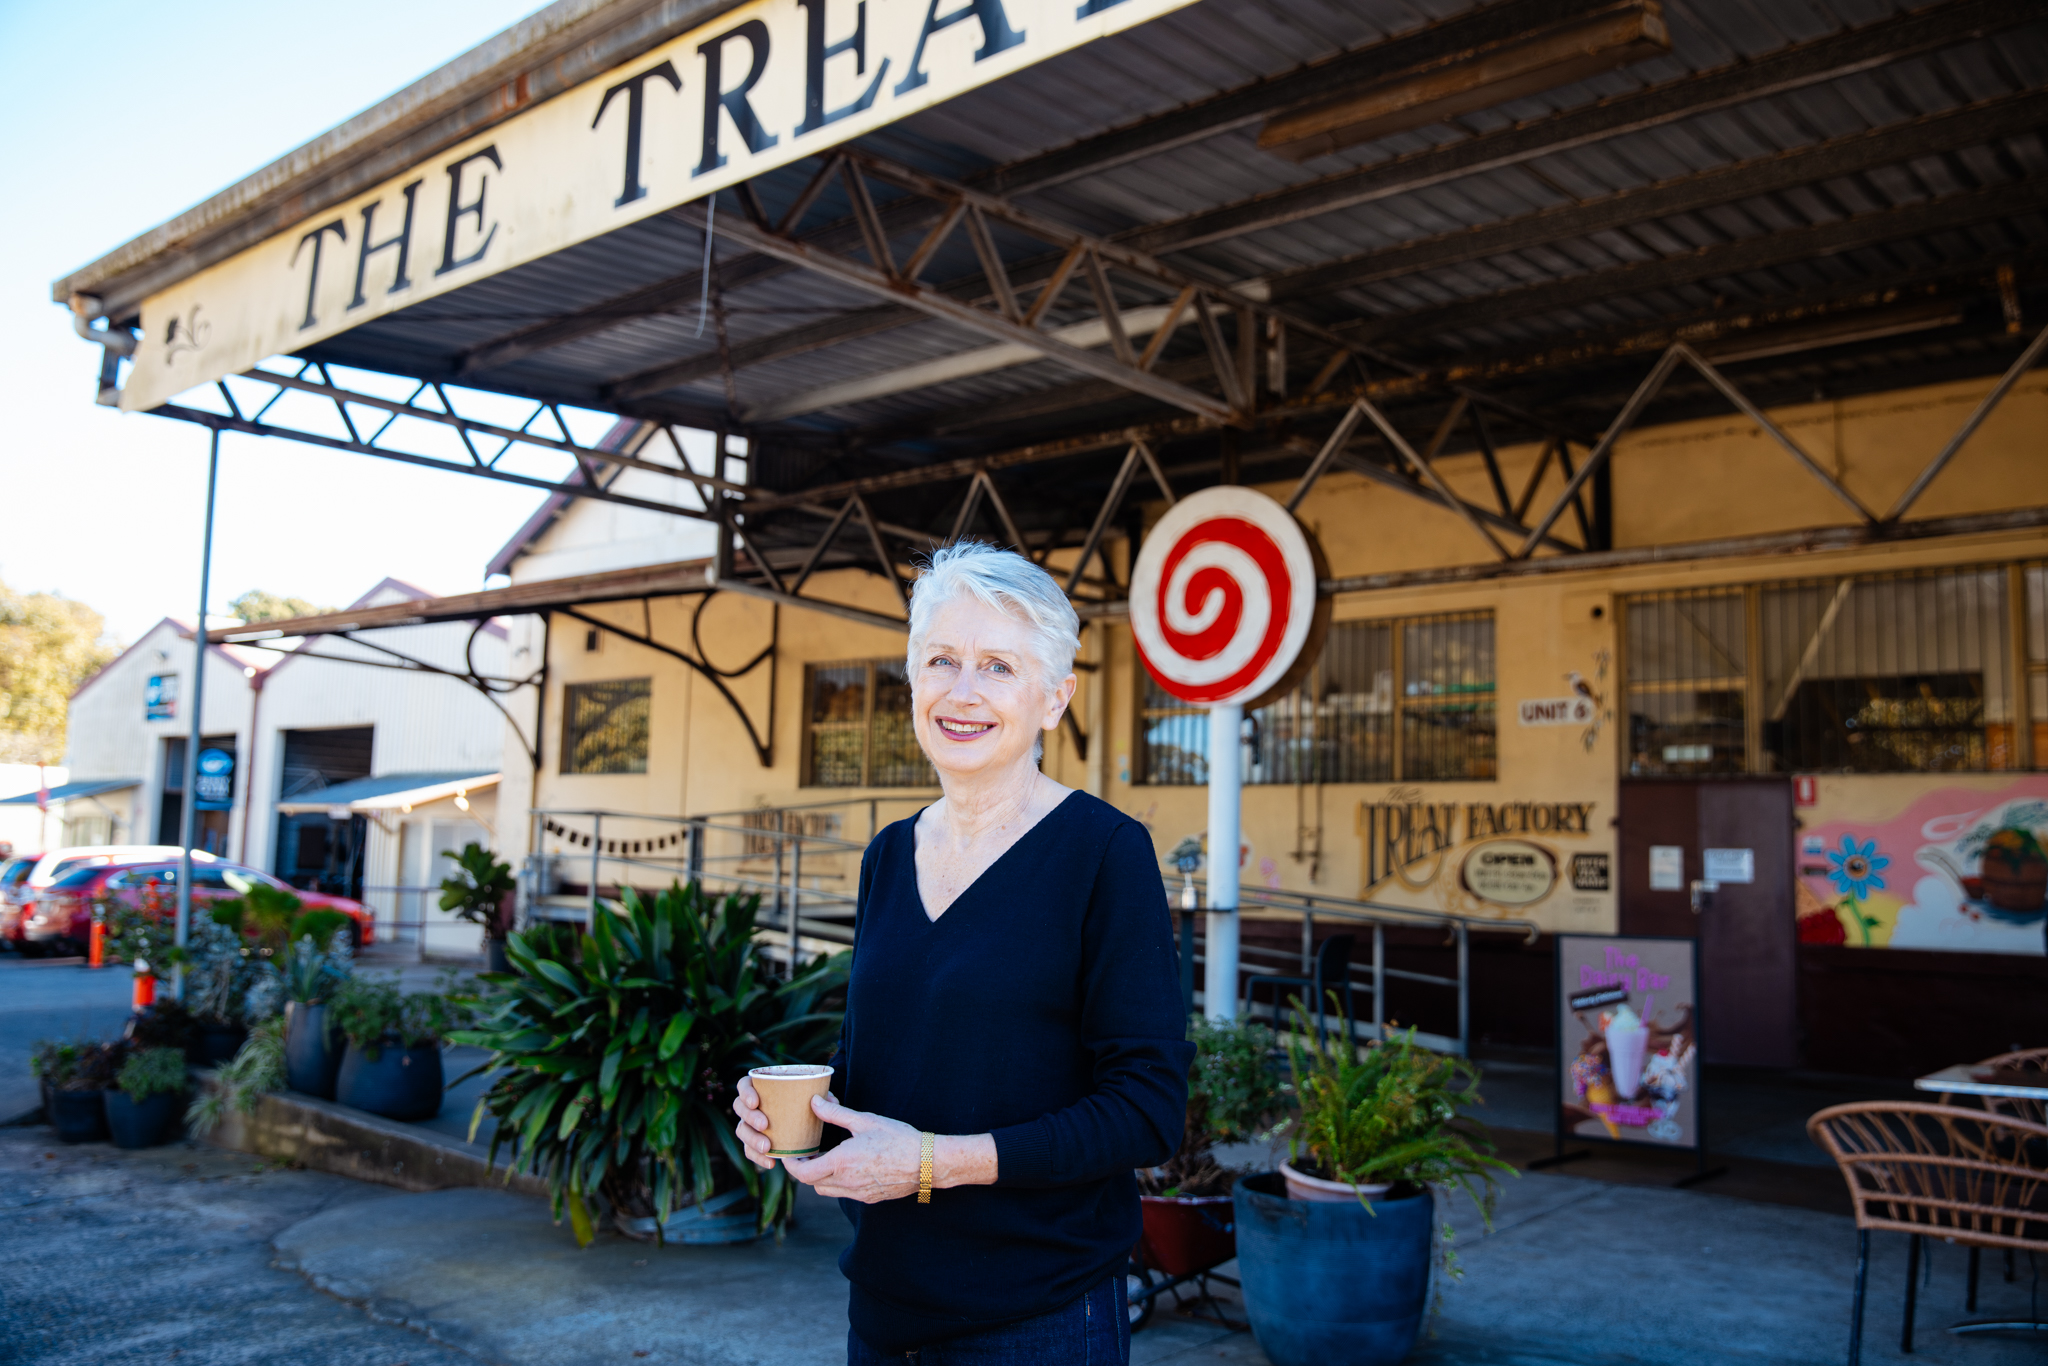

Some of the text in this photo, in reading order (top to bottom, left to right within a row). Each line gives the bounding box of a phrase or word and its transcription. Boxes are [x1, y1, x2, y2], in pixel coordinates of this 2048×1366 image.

[289, 0, 1132, 332] THE TREA
[1521, 701, 1568, 722] UNIT
[1360, 799, 1596, 890] TREAT FACTORY
[1480, 852, 1536, 867] OPEN
[1604, 946, 1640, 969] The
[1580, 964, 1672, 992] Dairy Bar
